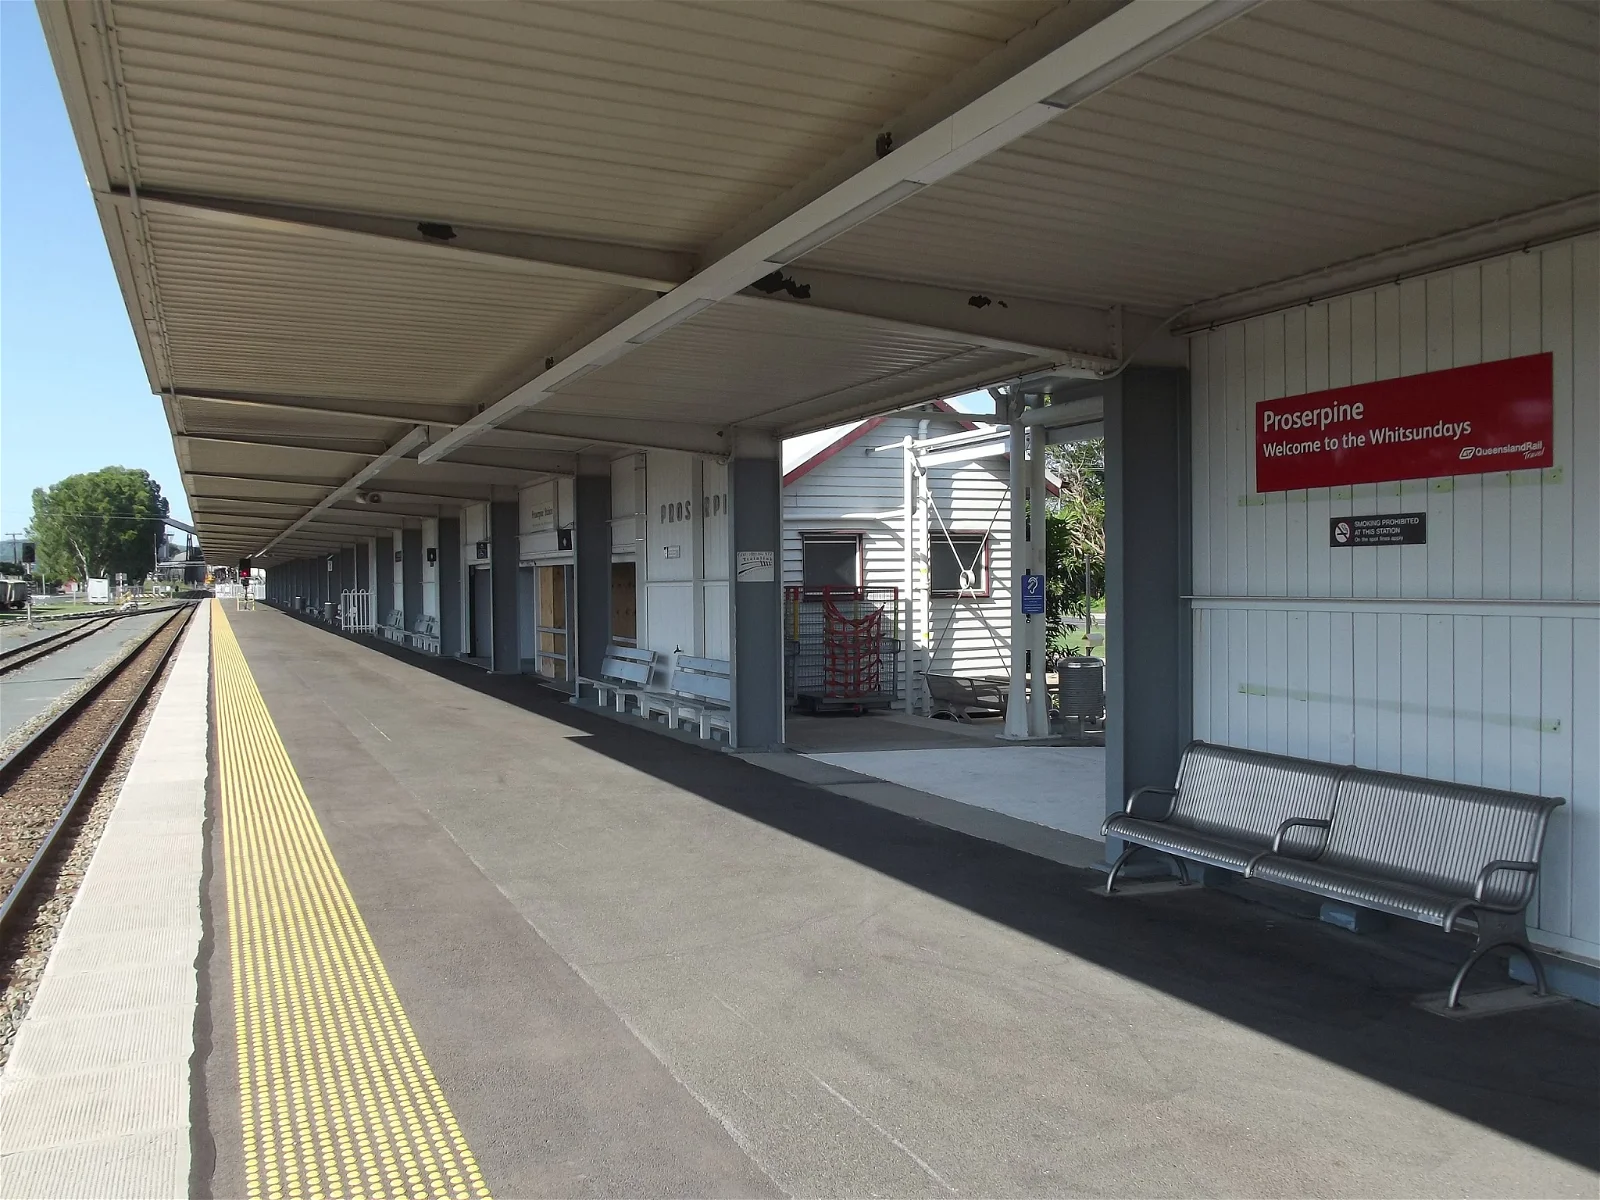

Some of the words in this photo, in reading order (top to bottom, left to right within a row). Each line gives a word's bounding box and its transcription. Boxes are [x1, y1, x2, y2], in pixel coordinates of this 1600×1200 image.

[1263, 400, 1364, 432] Proserpine
[1263, 440, 1321, 457] Welcome
[1324, 437, 1338, 451] to
[1342, 432, 1366, 449] the
[1369, 420, 1472, 445] Whitsundays
[1354, 520, 1381, 528] SMOKING
[1376, 527, 1401, 535] STATION
